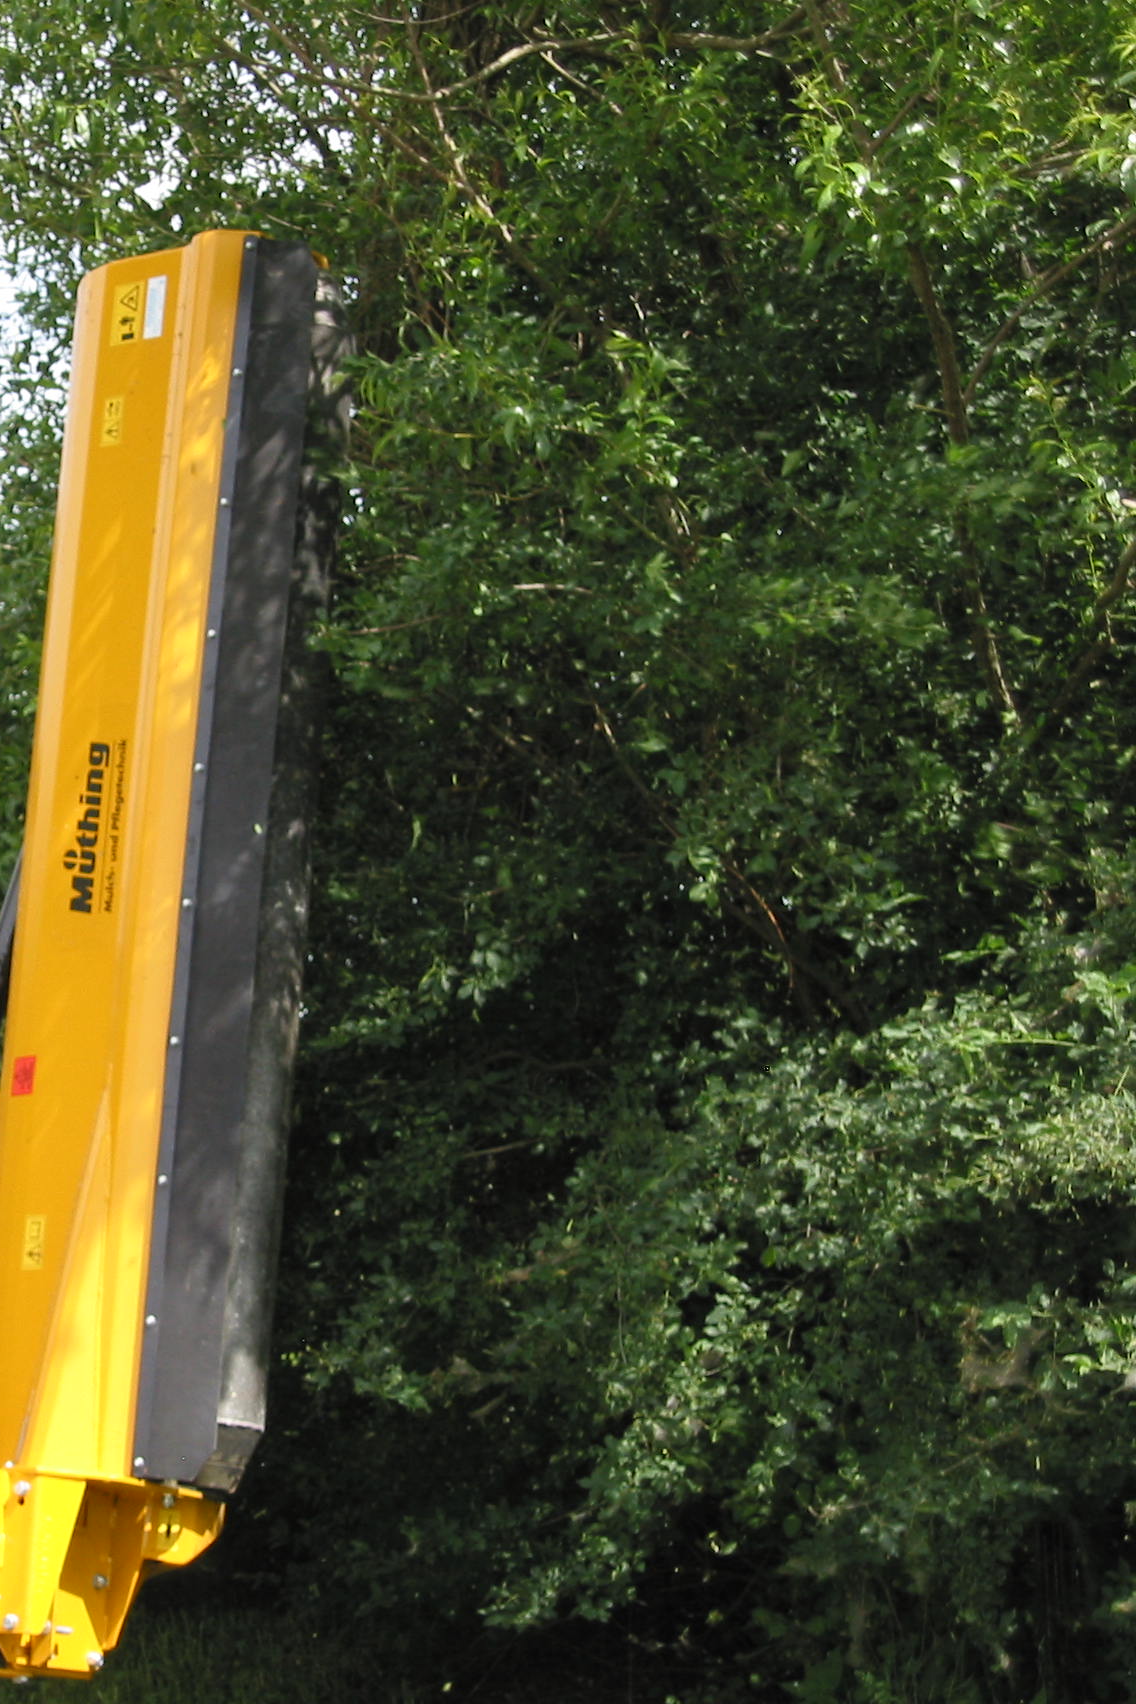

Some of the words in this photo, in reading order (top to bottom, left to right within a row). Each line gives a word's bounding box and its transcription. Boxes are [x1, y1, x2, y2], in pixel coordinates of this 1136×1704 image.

[63, 741, 111, 914] Müthing
[111, 739, 127, 830] Pflegetechnik
[111, 834, 119, 863] und
